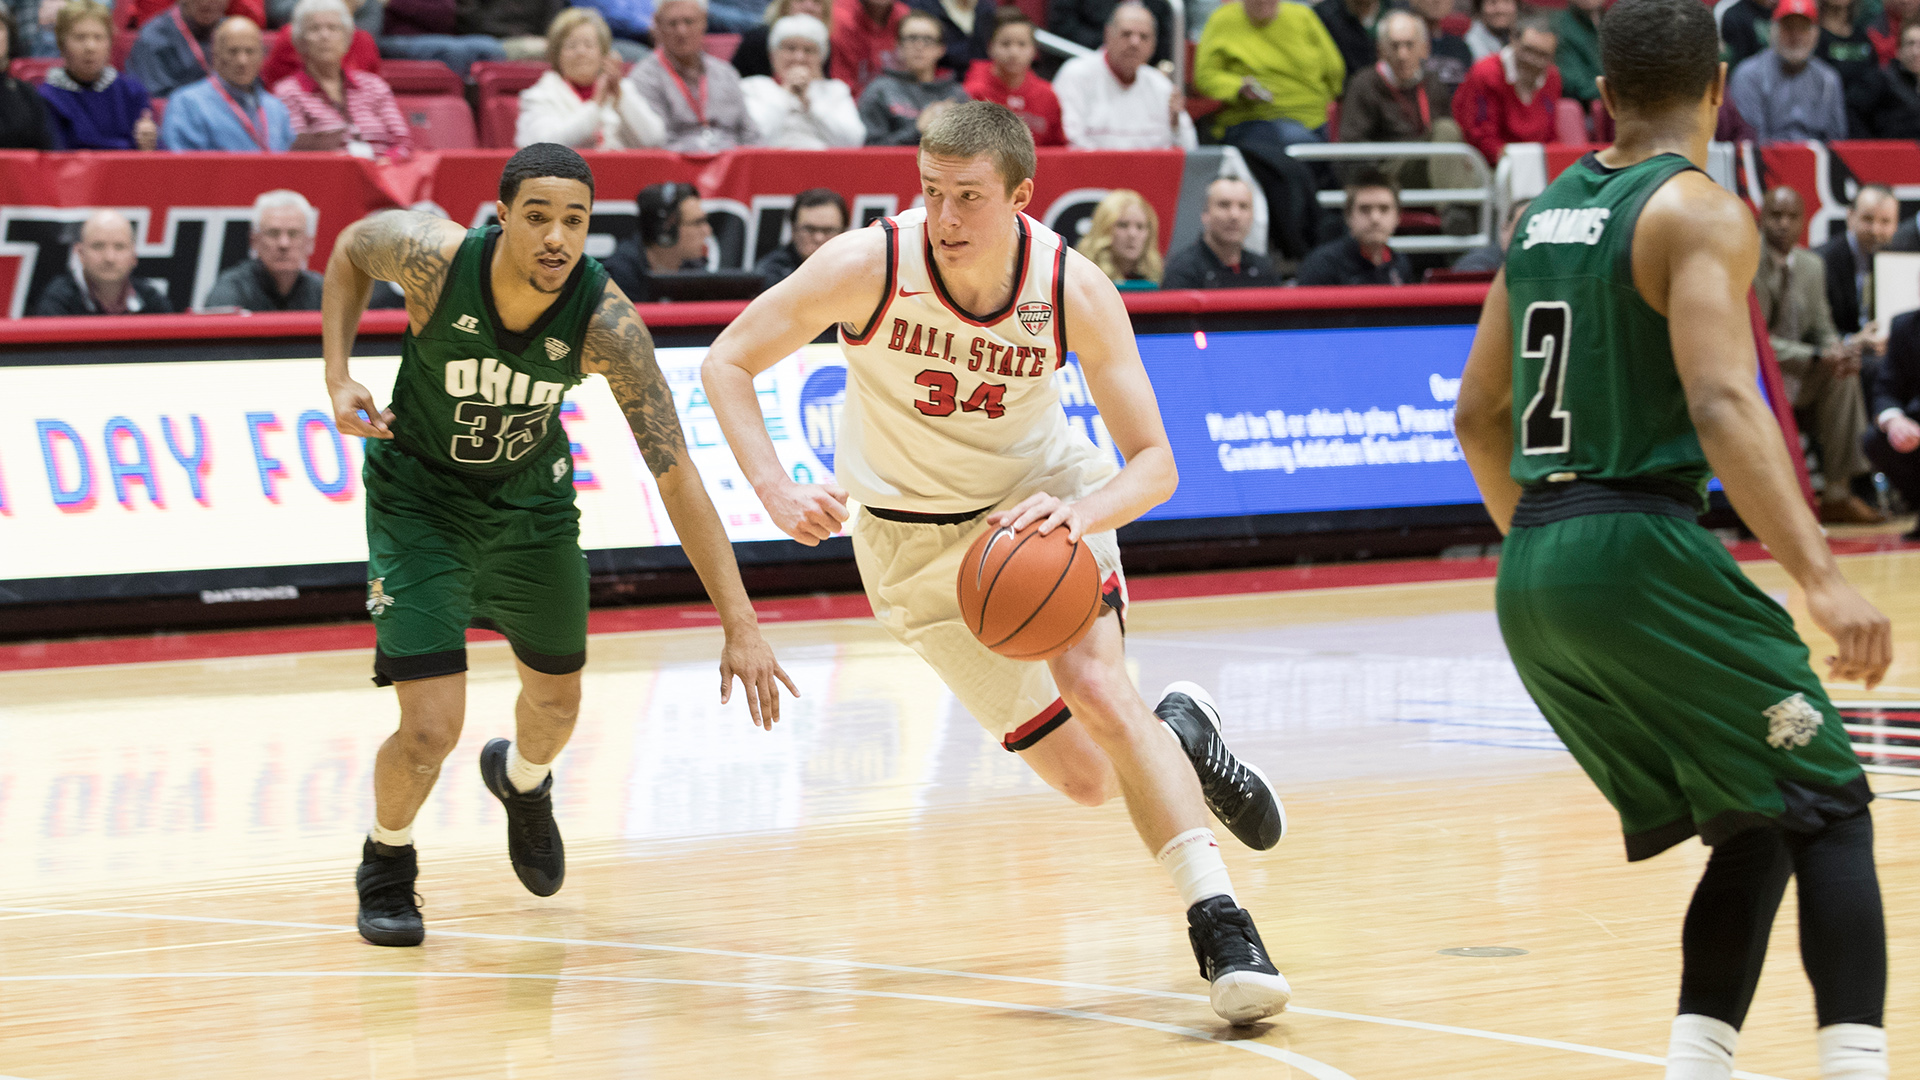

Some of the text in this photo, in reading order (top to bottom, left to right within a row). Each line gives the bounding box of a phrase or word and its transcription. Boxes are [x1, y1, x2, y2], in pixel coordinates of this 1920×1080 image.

[1020, 311, 1051, 322] MAC
[888, 318, 1047, 377] BALL STATE
[445, 358, 565, 406] OHIO
[914, 369, 1008, 419] 34
[1521, 301, 1572, 456] 2
[35, 413, 214, 514] DAY
[245, 409, 376, 506] FO
[450, 401, 554, 463] 35
